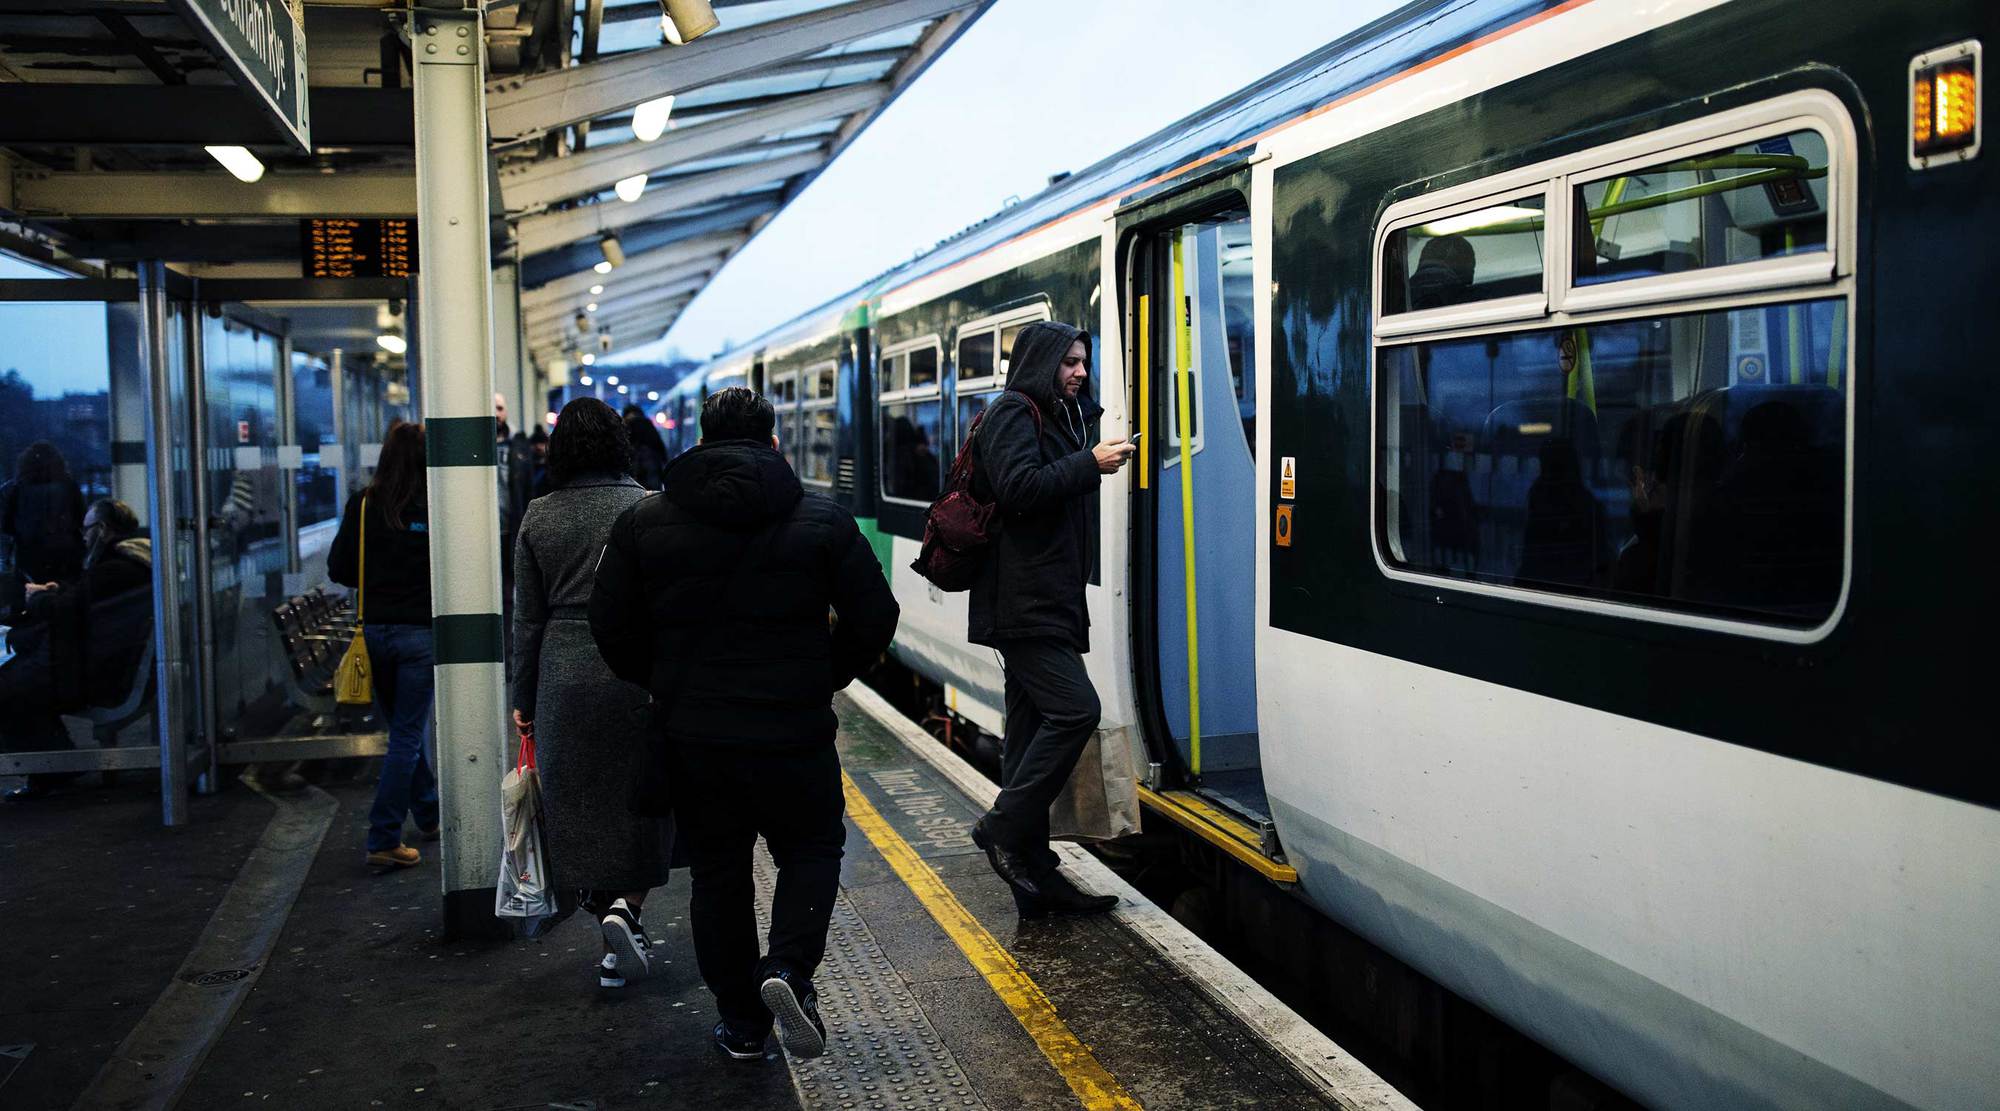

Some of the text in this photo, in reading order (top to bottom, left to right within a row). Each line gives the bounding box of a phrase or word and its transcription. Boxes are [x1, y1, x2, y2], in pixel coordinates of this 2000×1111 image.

[266, 1, 285, 100] Rye
[300, 72, 307, 128] 2
[868, 769, 975, 848] Mind the step
